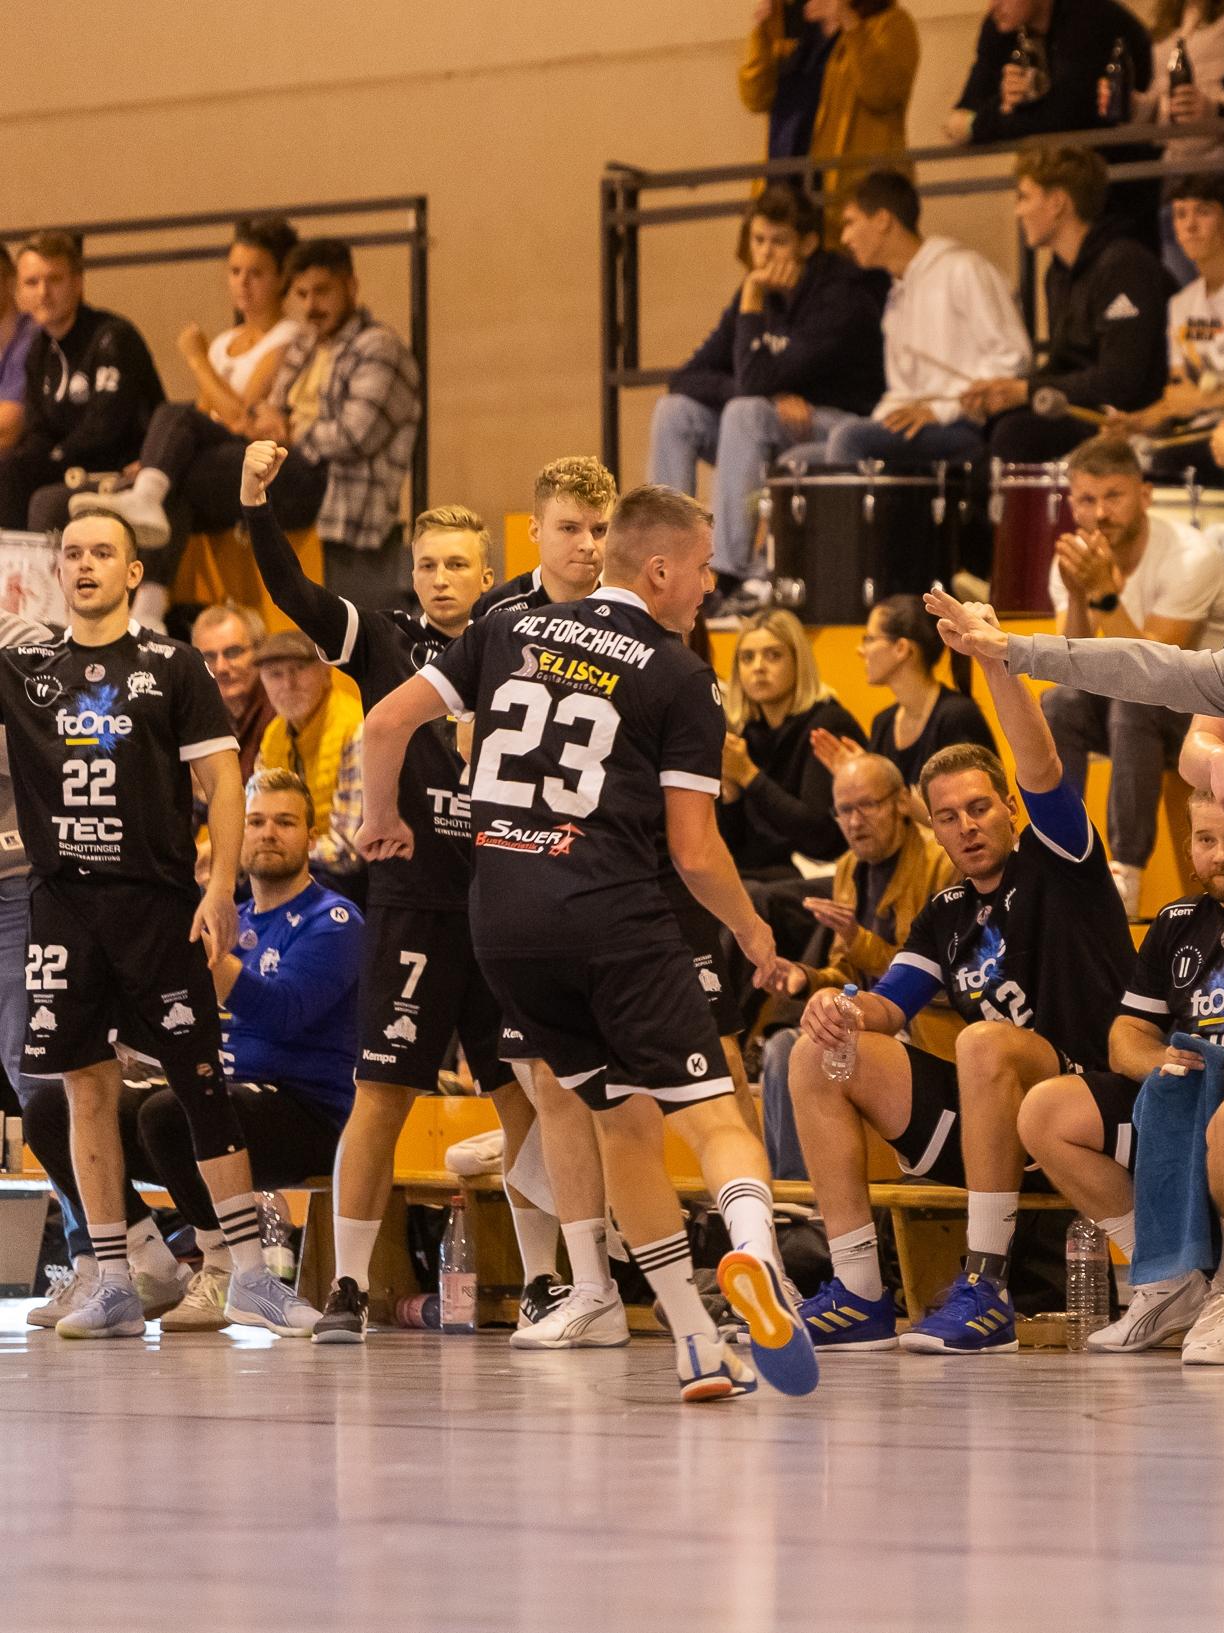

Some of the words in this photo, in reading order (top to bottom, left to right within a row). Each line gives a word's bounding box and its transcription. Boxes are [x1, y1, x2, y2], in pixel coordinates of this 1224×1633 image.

[513, 616, 546, 636] HC
[542, 618, 656, 670] FORCHHEIM
[539, 651, 620, 695] ELISCH
[471, 679, 620, 819] 23
[62, 758, 117, 807] 22
[427, 787, 471, 818] TE
[51, 816, 123, 841] TEC
[434, 816, 471, 829] SCHÜTTI
[484, 819, 563, 844] SAUER
[24, 944, 68, 990] 22
[399, 950, 428, 999] 7
[362, 1048, 397, 1064] Kempa
